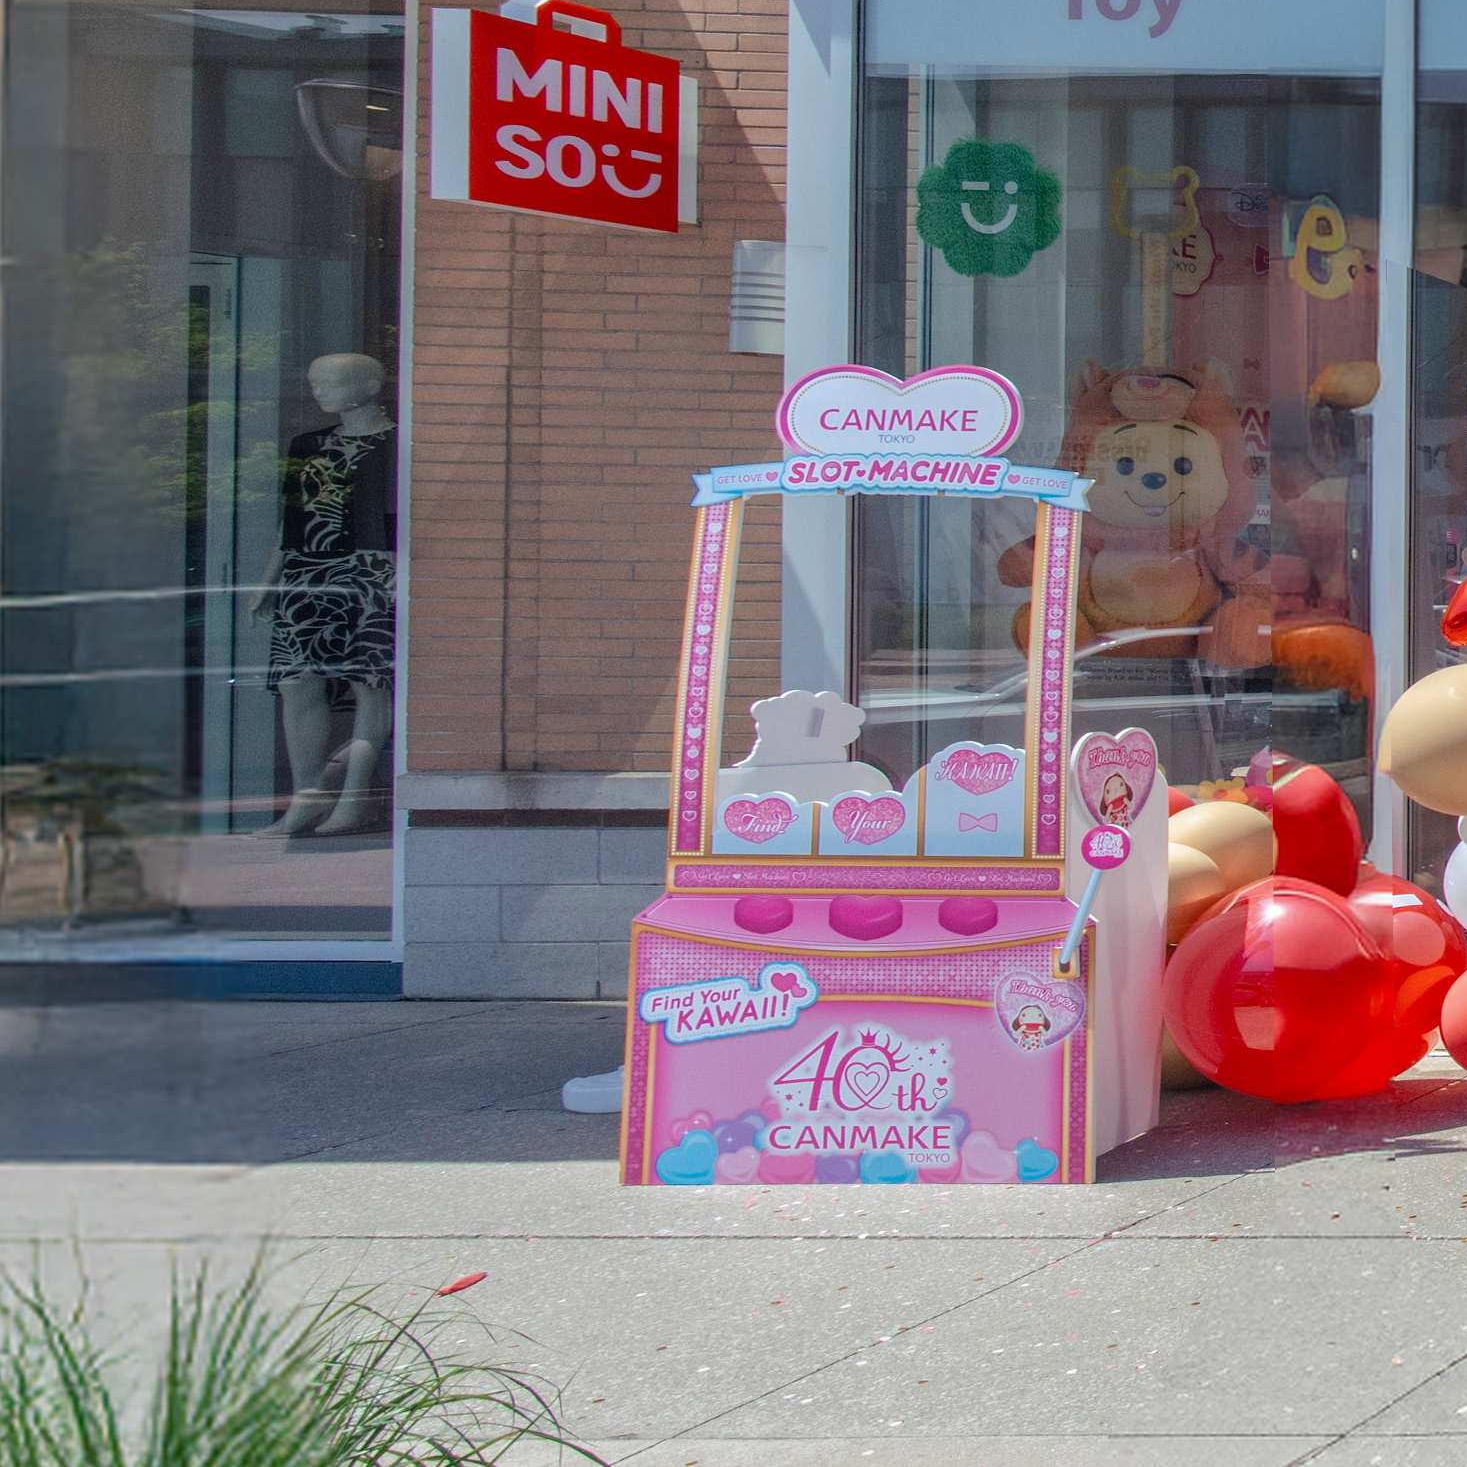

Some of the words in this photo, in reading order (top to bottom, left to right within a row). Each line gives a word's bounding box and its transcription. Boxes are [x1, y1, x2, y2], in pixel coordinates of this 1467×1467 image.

[495, 47, 664, 135] MINI
[819, 407, 979, 433] CANMAKE
[878, 434, 916, 445] TOKYO
[717, 475, 737, 485] GET
[738, 473, 763, 484] LOVE
[788, 460, 859, 484] SLOT
[868, 459, 1002, 486] MACHINE
[1021, 475, 1039, 486] GET
[1040, 477, 1069, 490] LOVE
[738, 814, 798, 835] Find
[843, 810, 893, 845] Your
[651, 991, 695, 1013] Find
[699, 986, 741, 1006] Your
[676, 993, 790, 1033] KAWAII!
[768, 1124, 951, 1151] CANMAKE
[907, 1152, 951, 1164] TOKYO
